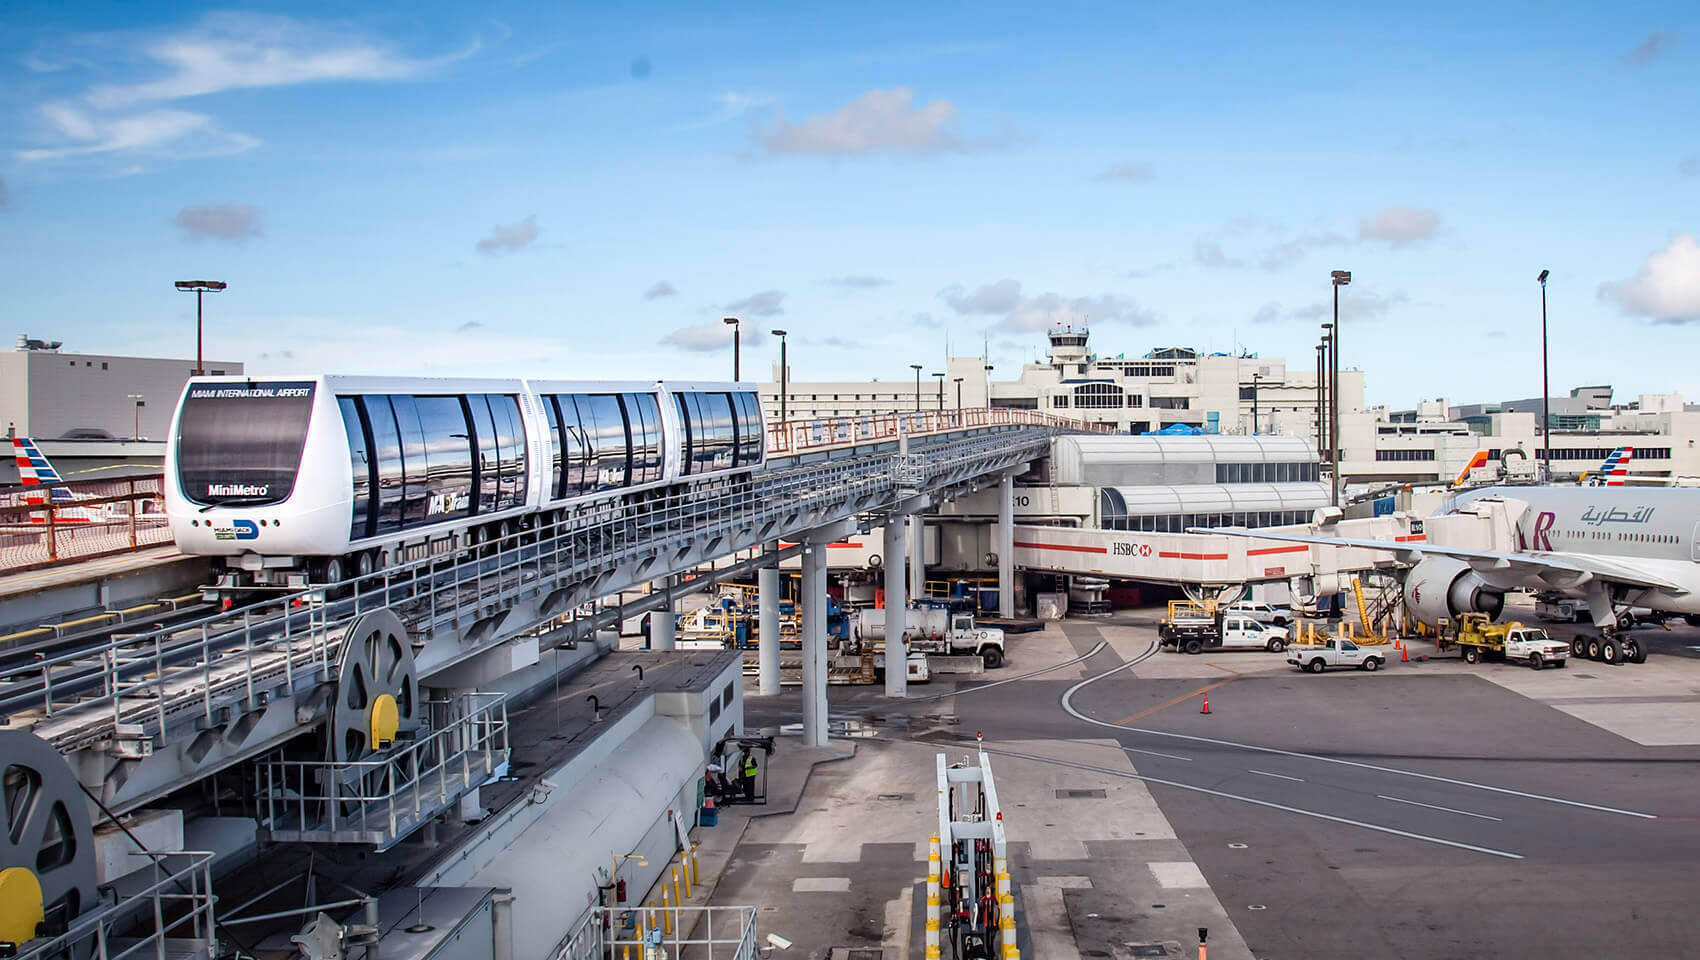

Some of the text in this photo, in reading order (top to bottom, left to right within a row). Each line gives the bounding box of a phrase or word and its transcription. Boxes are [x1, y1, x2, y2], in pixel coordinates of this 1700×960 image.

[191, 387, 311, 399] MIAMI INTERNATIONAL AIRPORT
[208, 484, 268, 496] MiniMetro
[1013, 496, 1030, 507] 10
[1581, 505, 1656, 526] القطرية
[1113, 542, 1138, 557] HSBC
